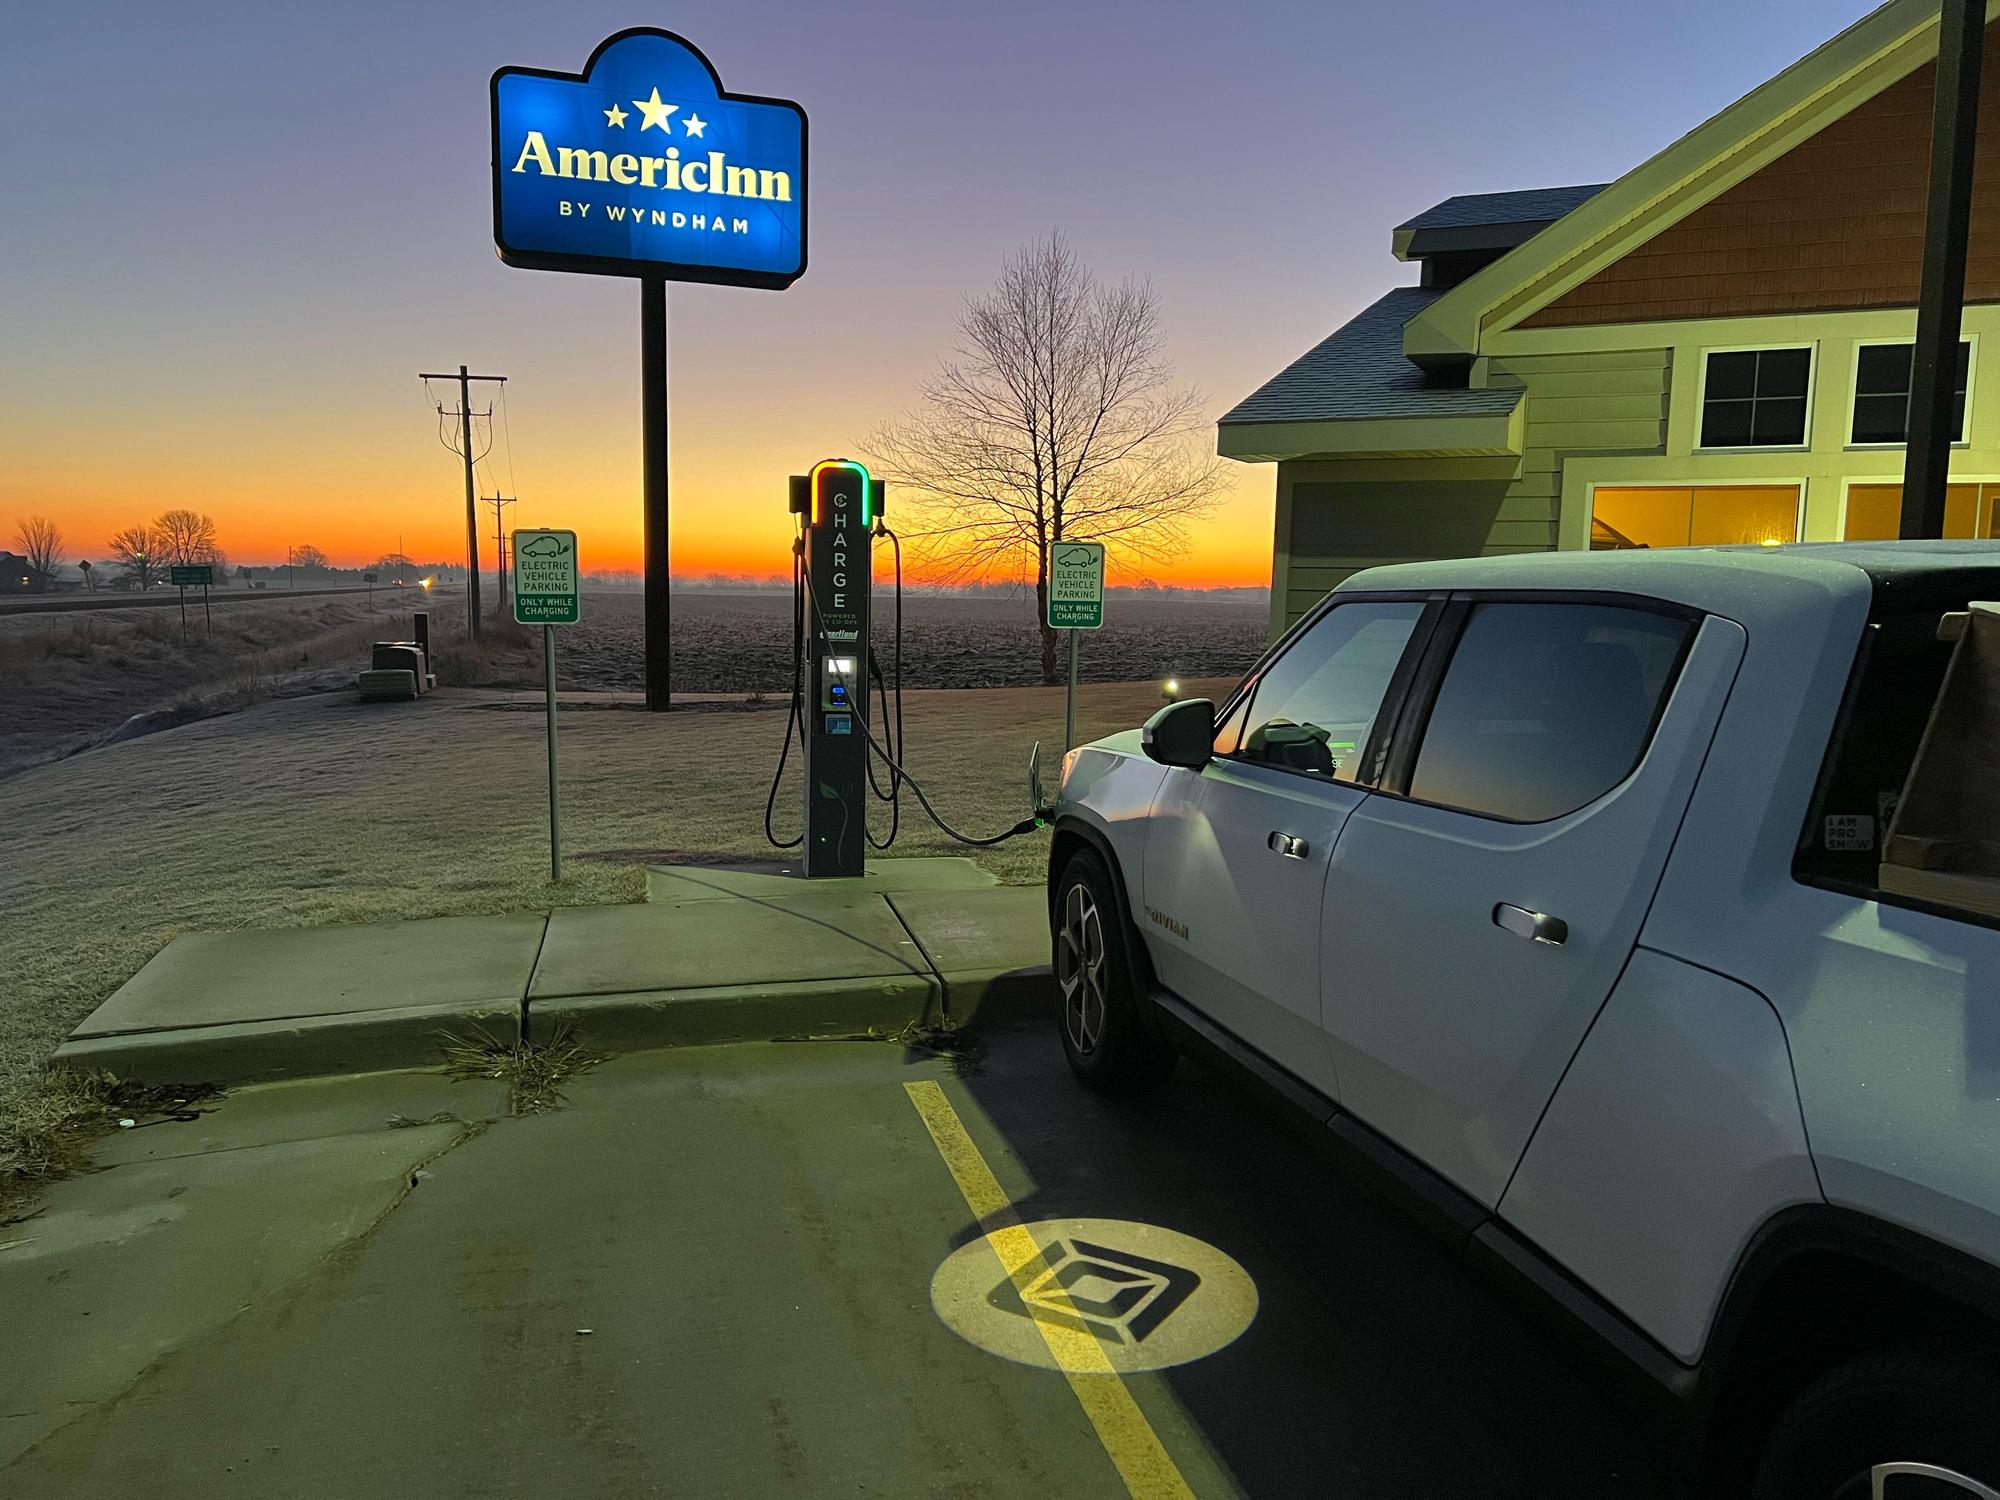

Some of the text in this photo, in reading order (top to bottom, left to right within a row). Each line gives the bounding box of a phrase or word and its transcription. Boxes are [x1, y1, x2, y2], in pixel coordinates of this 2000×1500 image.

[511, 131, 792, 202] AmericInn
[560, 201, 748, 234] BY WYNDHAM
[833, 493, 847, 608] CHARGE
[521, 561, 569, 570] ELECTRIC
[524, 572, 567, 581] VEHICLE
[1056, 571, 1097, 579] ELECTRIC
[524, 582, 568, 592] PARKING
[1058, 581, 1095, 589] VEHICLE
[1057, 590, 1095, 599] PARKING
[520, 598, 573, 606] ONLY WHILE
[525, 607, 569, 615] CHARGING
[1053, 604, 1098, 612] ONLY WHILE
[1056, 612, 1095, 620] CHARGING
[1151, 910, 1189, 941] RIVIAN
